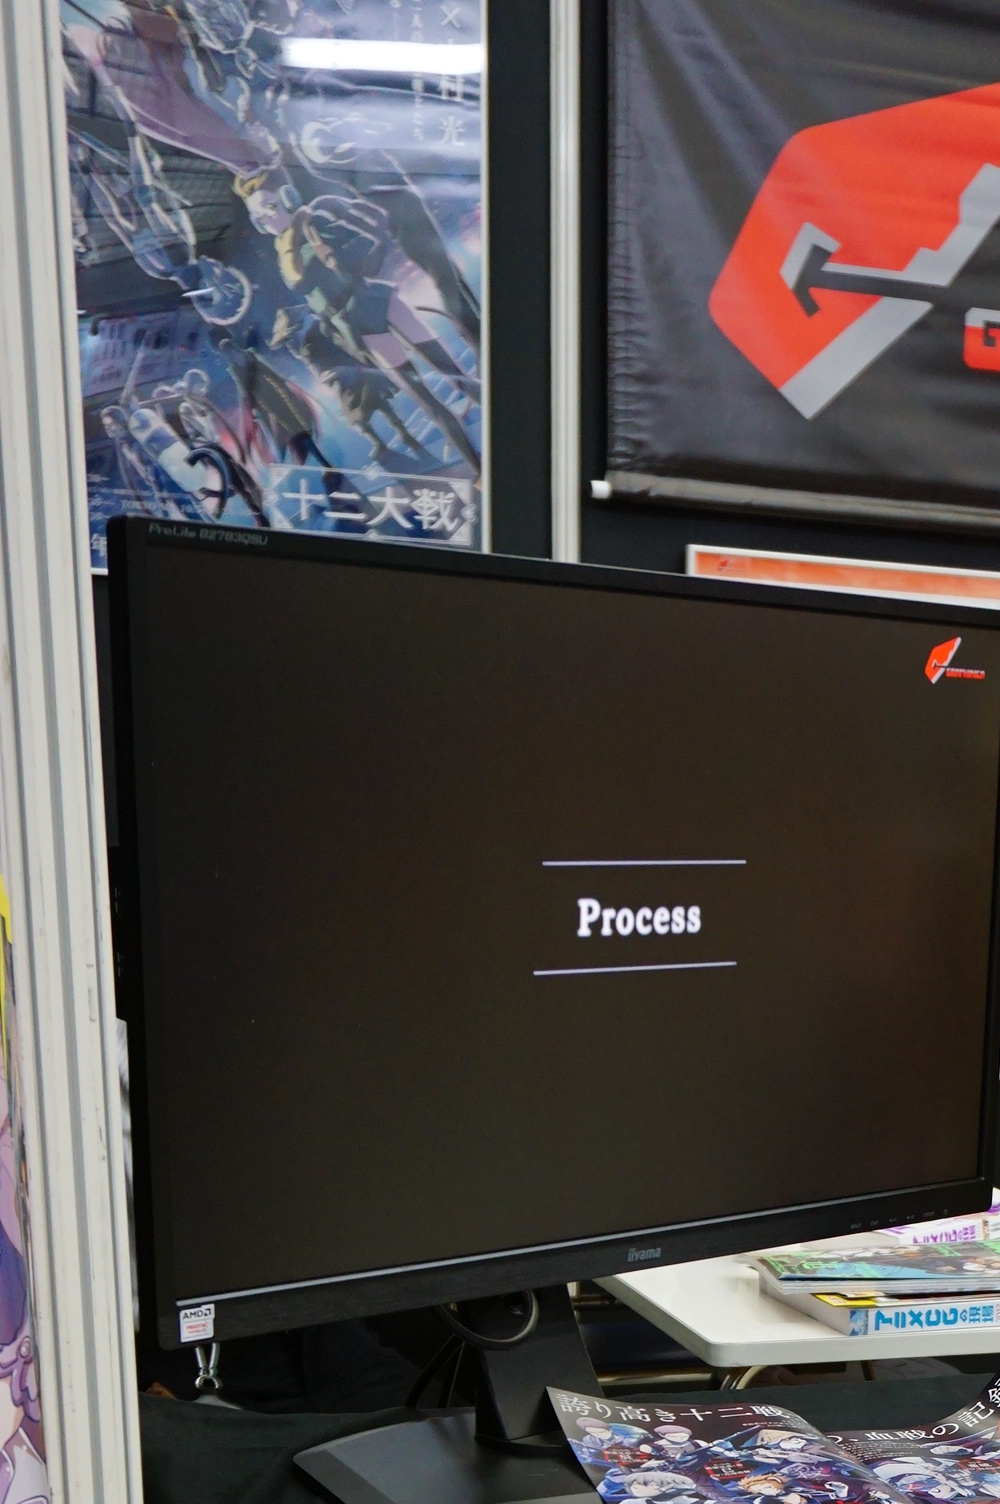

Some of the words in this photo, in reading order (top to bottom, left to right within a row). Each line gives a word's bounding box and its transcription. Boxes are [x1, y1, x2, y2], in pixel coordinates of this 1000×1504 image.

[282, 478, 459, 532] 十二大戦
[577, 898, 701, 937] Process
[628, 1247, 662, 1263] iiyama
[183, 1309, 204, 1320] AMD
[873, 1304, 995, 1331] アニメCGの現場
